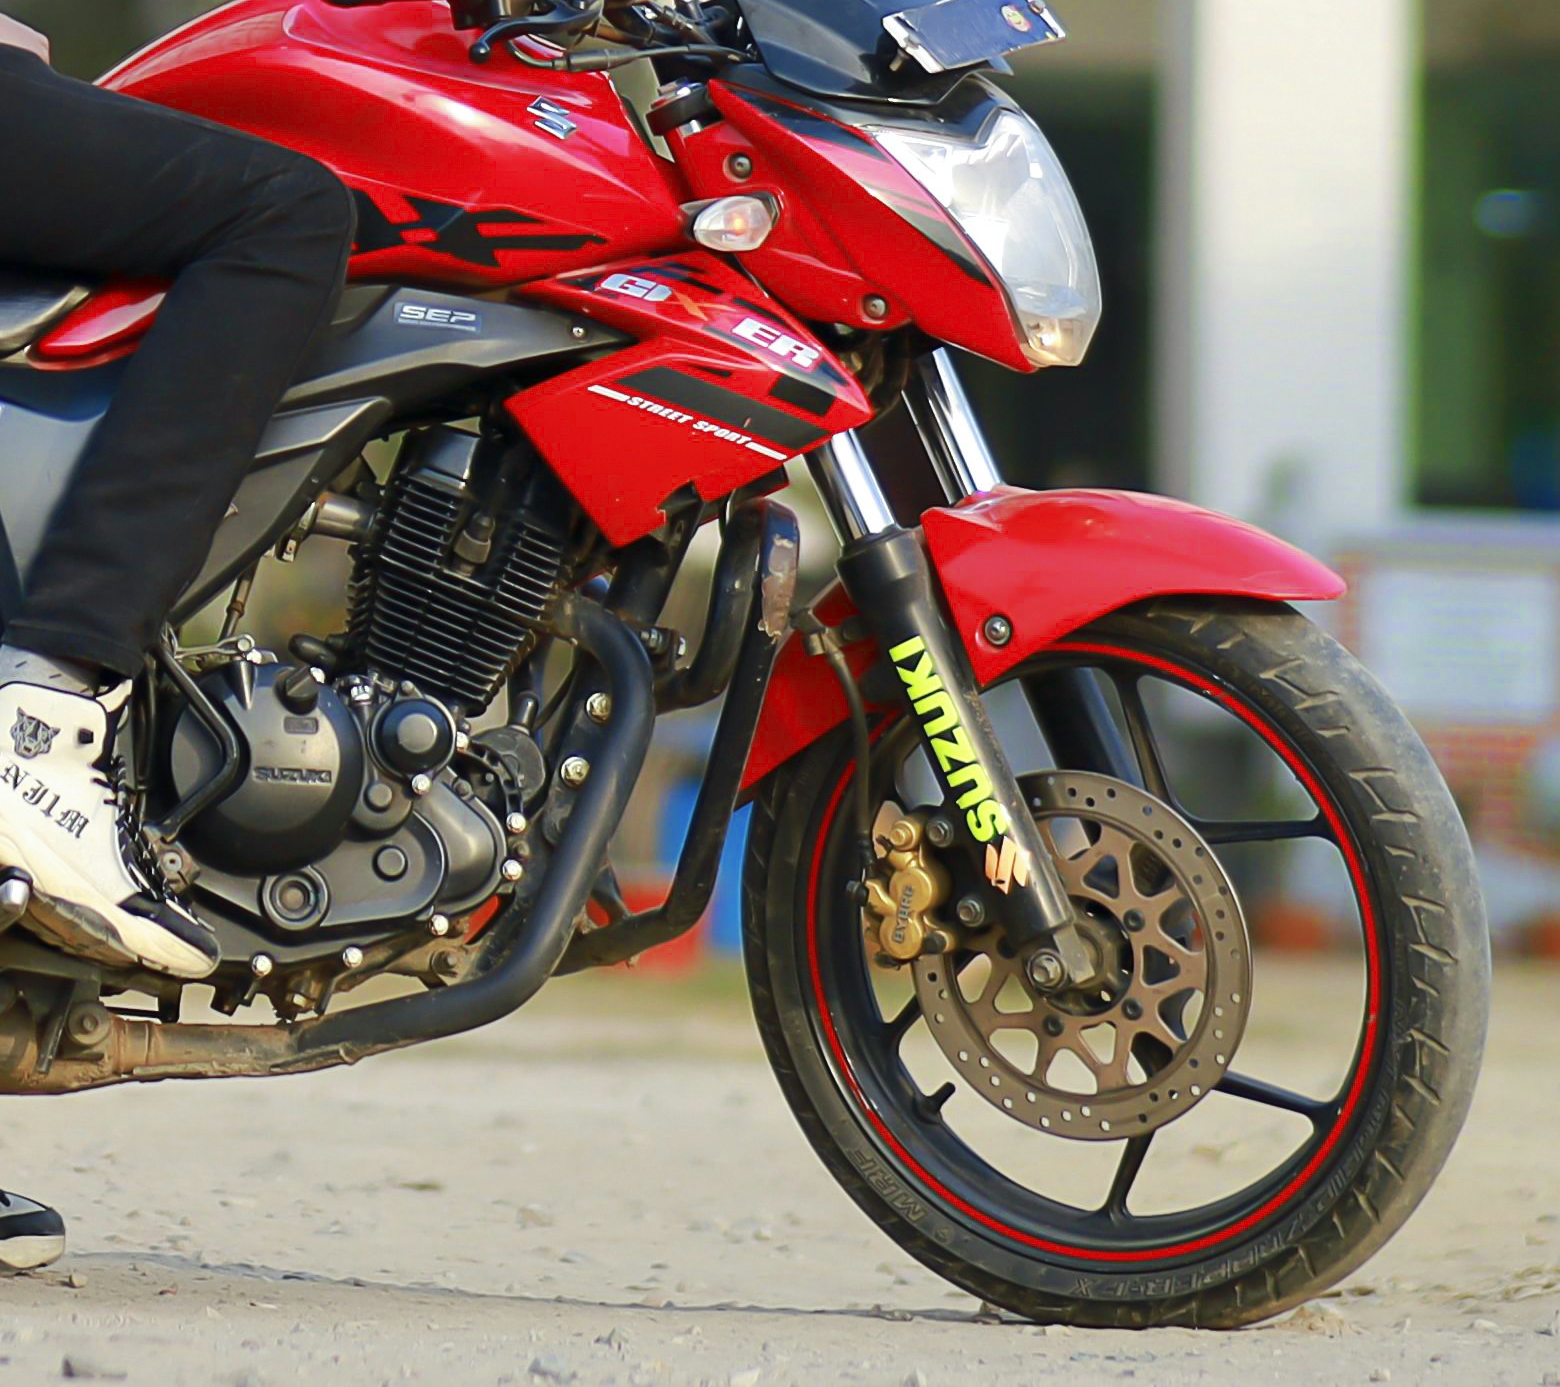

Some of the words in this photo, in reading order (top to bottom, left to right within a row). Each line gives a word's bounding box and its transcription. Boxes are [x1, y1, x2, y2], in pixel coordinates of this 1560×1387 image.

[399, 305, 476, 323] SEP
[627, 395, 694, 424] STREET
[692, 420, 753, 445] SPORT
[888, 635, 1008, 843] SUZUKI
[252, 767, 332, 785] SUZUKI
[853, 1147, 928, 1223] MRF
